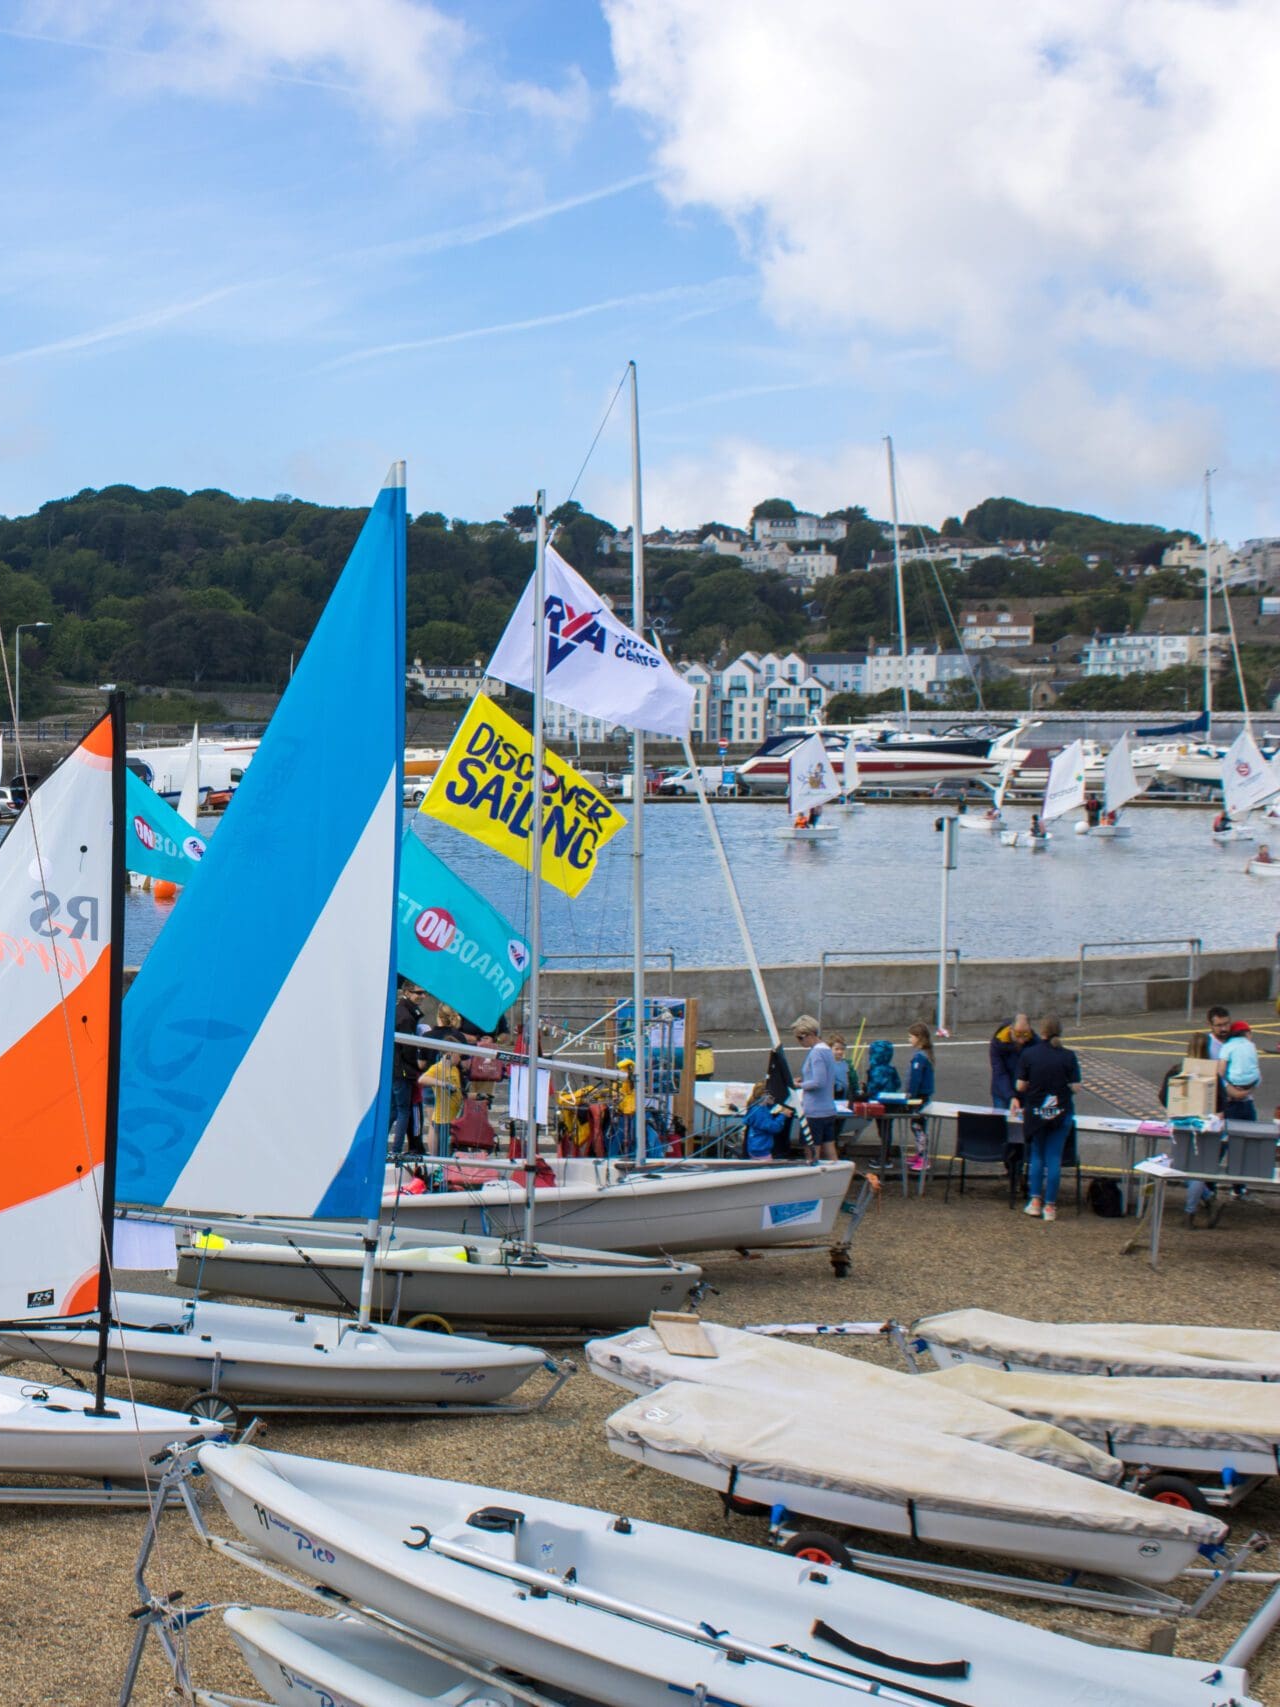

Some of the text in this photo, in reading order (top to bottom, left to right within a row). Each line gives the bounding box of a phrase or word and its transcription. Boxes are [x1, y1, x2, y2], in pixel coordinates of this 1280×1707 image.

[614, 643, 661, 668] Centre
[33, 1291, 52, 1302] RS
[292, 1531, 336, 1564] Pico
